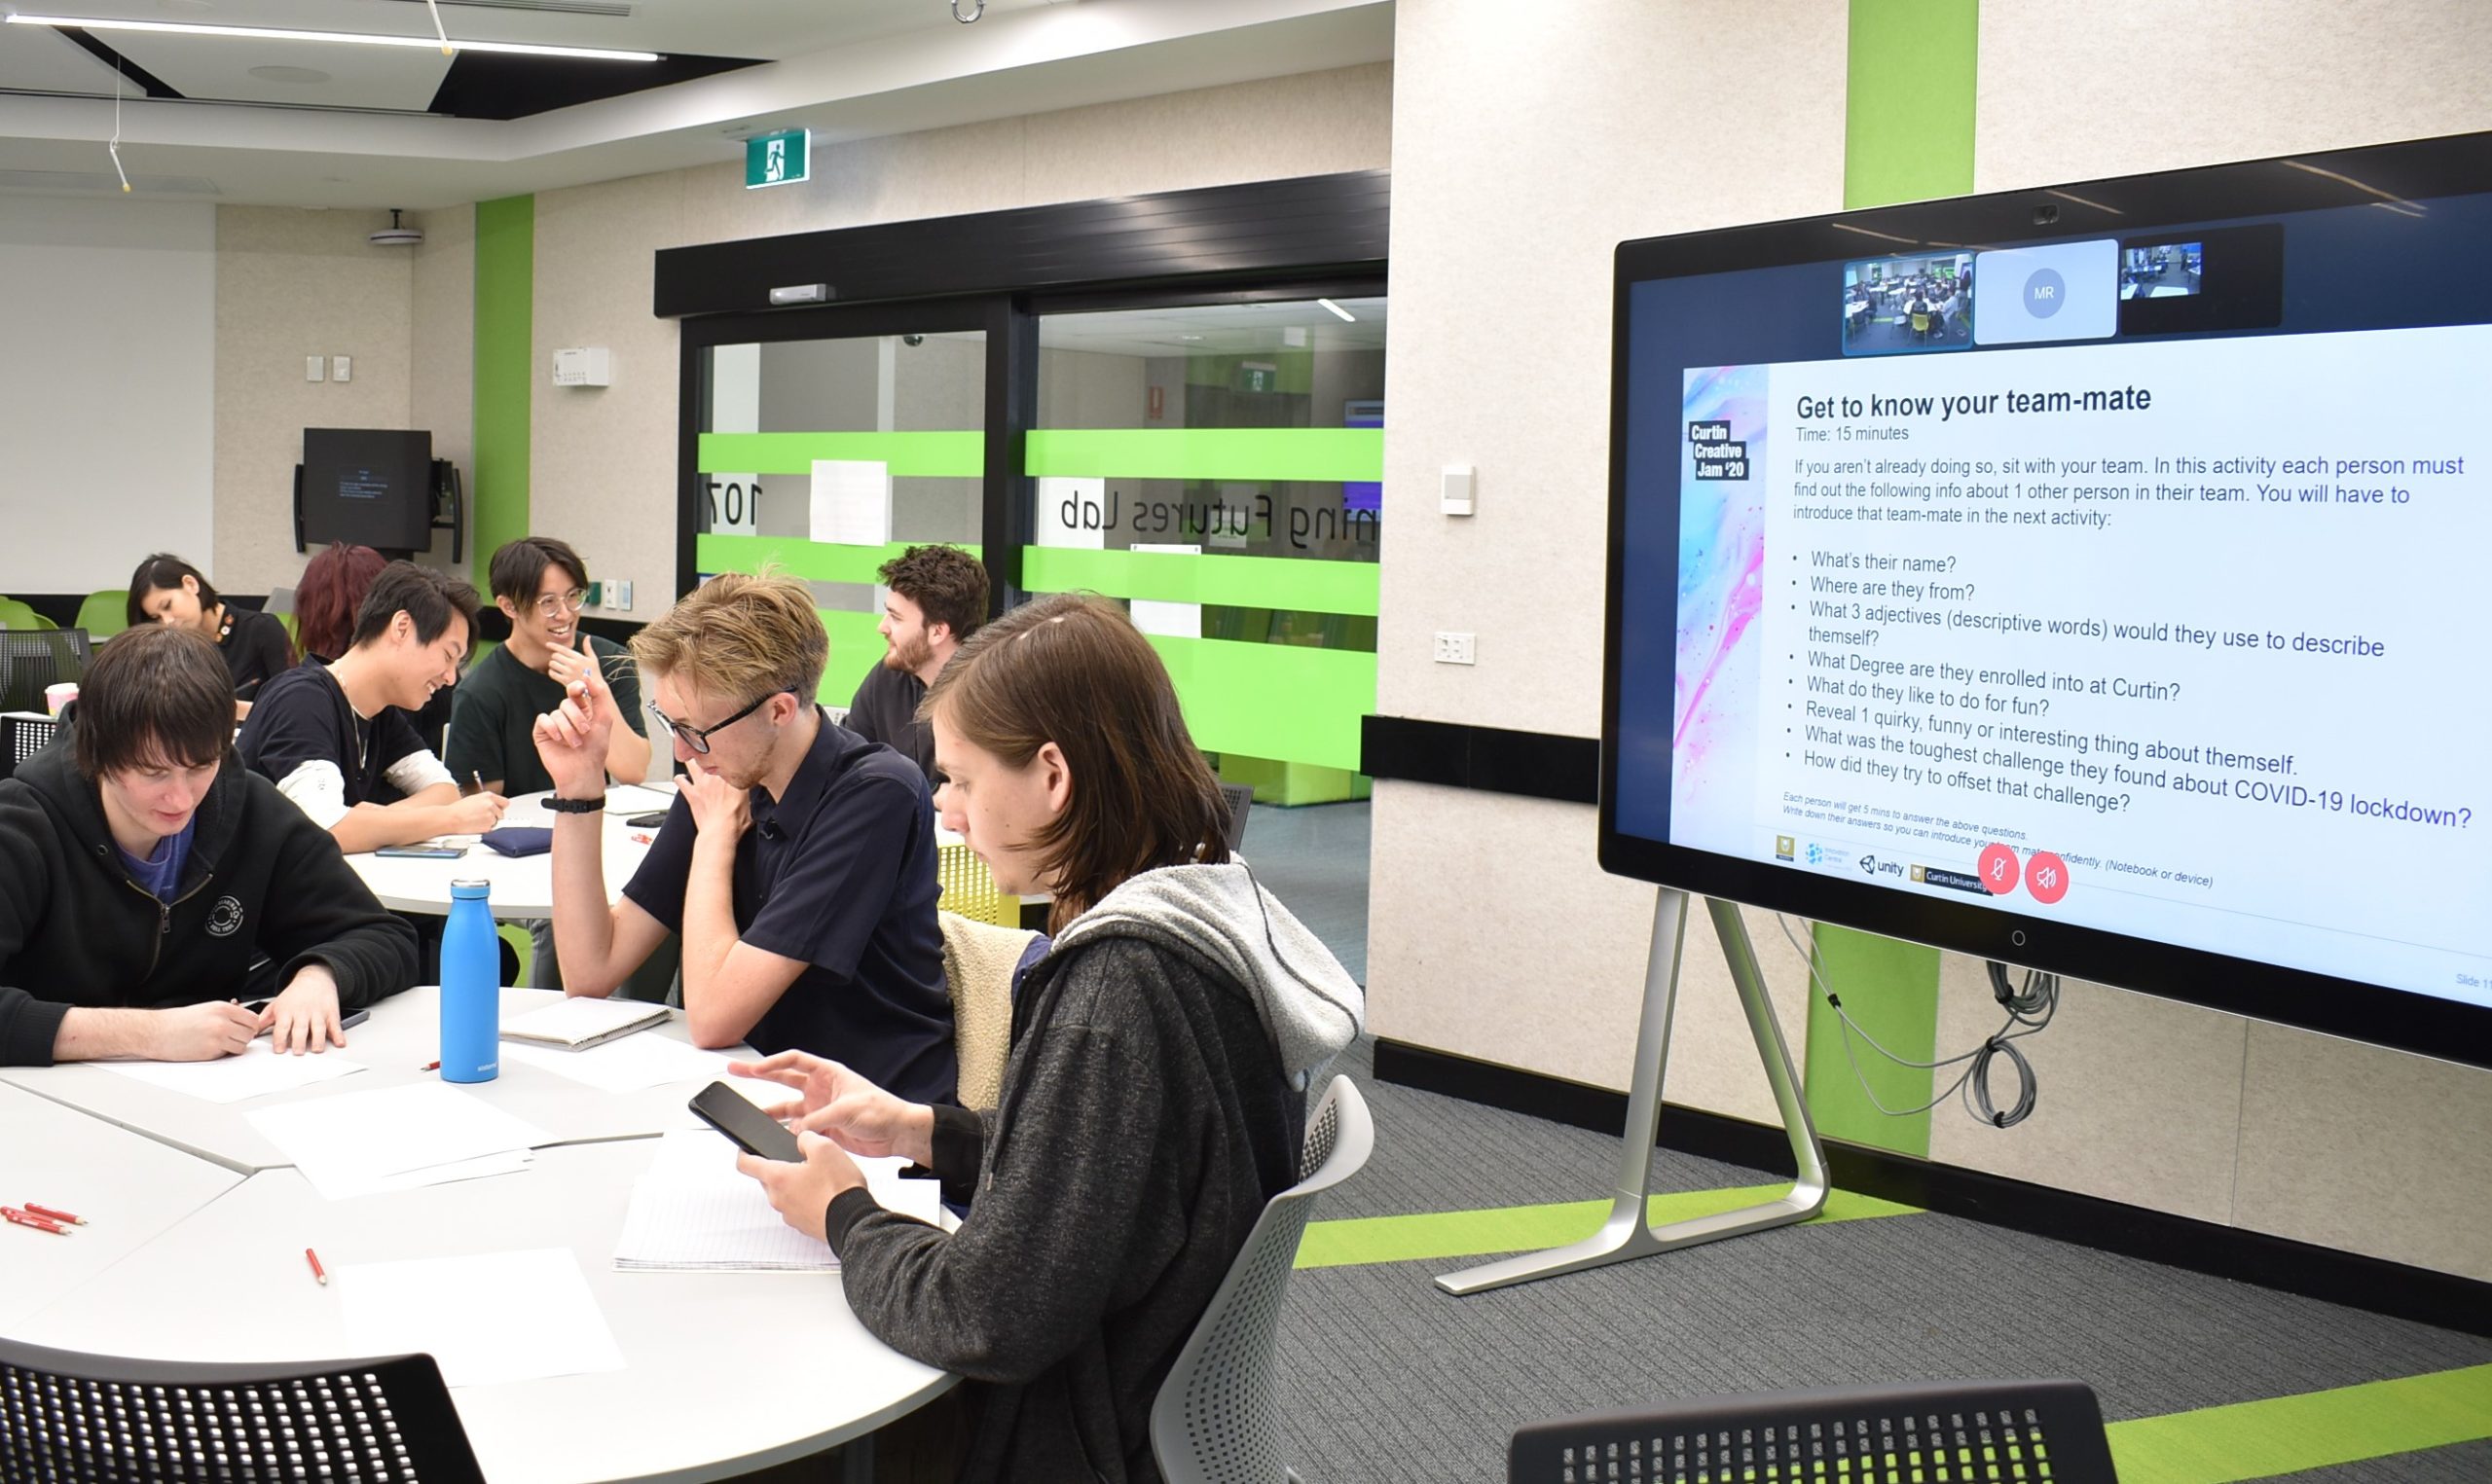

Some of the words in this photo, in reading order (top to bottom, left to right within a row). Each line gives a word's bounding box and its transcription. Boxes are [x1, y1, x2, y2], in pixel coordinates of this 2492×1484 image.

[2034, 286, 2055, 301] MR
[1796, 395, 1836, 420] Get
[1840, 395, 1864, 418] to
[1870, 392, 1935, 417] know
[1940, 393, 2000, 422] your
[2005, 384, 2152, 415] team-mate
[1691, 424, 1727, 441] Curtin
[1795, 426, 1831, 442] Time:
[1836, 425, 1852, 442] 15
[1855, 425, 1910, 441] minutes
[1695, 443, 1742, 459] Creative
[1697, 461, 1723, 478] Jam
[1795, 458, 1804, 474] If
[1806, 462, 1830, 478] you
[1833, 458, 1872, 474] aren't
[1874, 458, 1927, 478] already
[1930, 457, 1971, 479] doing
[1975, 461, 1997, 477] so,
[2001, 457, 2021, 474] sit
[2024, 456, 2056, 474] with
[2060, 460, 2098, 479] your
[2101, 457, 2148, 474] team.
[2154, 456, 2171, 474] In
[2175, 455, 2208, 474] this
[2212, 455, 2277, 479] activity
[2282, 455, 2329, 475] each
[2335, 459, 2405, 480] person
[2412, 455, 2465, 475] must
[1793, 481, 1817, 497] find
[1820, 482, 1842, 497] out
[1845, 482, 1867, 497] the
[1869, 482, 1931, 502] following
[1935, 482, 1962, 498] info
[1965, 482, 2009, 499] about
[2014, 482, 2021, 499] 1
[2027, 482, 2070, 500] other
[2072, 487, 2130, 504] person
[2135, 483, 2150, 500] in
[2155, 483, 2195, 501] their
[2199, 484, 2251, 502] team.
[2255, 483, 2292, 503] You
[2297, 484, 2328, 503] will
[2335, 484, 2385, 504] have
[2390, 486, 2410, 504] to
[1793, 504, 1853, 521] introduce
[1856, 505, 1883, 522] that
[1887, 506, 1963, 523] team-mate
[1966, 506, 1980, 523] in
[1984, 506, 2009, 525] the
[2013, 508, 2047, 525] next
[2050, 508, 2111, 530] activity:
[1811, 550, 1860, 569] What's
[1864, 553, 1898, 571] their
[1902, 555, 1957, 573] name?
[1810, 575, 1858, 595] Where
[1861, 582, 1887, 597] are
[1890, 579, 1925, 602] they
[1928, 581, 1975, 601] from?
[1809, 599, 1848, 619] What
[1851, 602, 1861, 620] 3
[1864, 603, 1942, 627] adjectives
[1947, 608, 2042, 634] (descriptive
[2047, 617, 2108, 642] words)
[2113, 622, 2169, 642] would
[2174, 623, 2217, 650] they
[2222, 631, 2259, 648] use
[2265, 630, 2286, 650] to
[2291, 631, 2385, 658] describe
[1809, 625, 1880, 647] themself?
[1808, 649, 1846, 670] What
[1850, 653, 1905, 677] Degree
[1909, 664, 1935, 678] are
[1939, 662, 1974, 686] they
[1978, 669, 2046, 689] enrolled
[2052, 671, 2084, 693] into
[2089, 676, 2107, 696] at
[2112, 677, 2180, 702] Curtin?
[1807, 674, 1845, 696] What
[1848, 679, 1868, 698] do
[1871, 681, 1905, 706] they
[1908, 685, 1935, 705] like
[1939, 689, 1955, 707] to
[1959, 691, 1980, 709] do
[1984, 693, 2008, 713] for
[2011, 695, 2050, 717] fun?
[1806, 700, 1856, 722] Reveal
[1861, 706, 1868, 724] 1
[1874, 709, 1923, 734] quirky,
[1927, 713, 1973, 741] funny
[1977, 724, 1995, 739] or
[1998, 721, 2089, 755] interesting
[2094, 733, 2139, 761] thing
[2144, 740, 2200, 764] about
[2205, 745, 2298, 776] themself.
[1804, 748, 1837, 770] How
[1840, 755, 1862, 774] did
[1866, 758, 1899, 783] they
[1903, 764, 1924, 786] try
[1927, 767, 1943, 785] to
[1946, 770, 1993, 793] offset
[1997, 777, 2029, 798] that
[2033, 781, 2131, 814] challenge?
[1805, 724, 1843, 745] What
[1846, 734, 1877, 749] was
[1881, 735, 1905, 753] the
[1909, 739, 1978, 764] toughest
[1982, 747, 2065, 778] challenge
[2070, 758, 2109, 785] they
[2113, 763, 2167, 789] found
[2172, 772, 2228, 797] about
[2234, 778, 2344, 812] COVID-19
[2350, 793, 2473, 829] lockdown?
[1783, 791, 1804, 802] Each
[1805, 796, 1832, 810] person
[1834, 800, 1847, 811] will
[1848, 804, 1861, 814] get
[1863, 805, 1869, 814] 5
[1871, 808, 1890, 818] mins
[1892, 810, 1901, 819] to
[1903, 814, 1934, 825] answer
[1936, 816, 1950, 827] the
[1952, 819, 1979, 833] above
[1783, 805, 1803, 816] Write
[1805, 809, 1826, 820] down
[1828, 813, 1846, 823] their
[1847, 816, 1882, 830] answers
[1883, 822, 1893, 832] so
[1895, 825, 1912, 836] you
[1913, 828, 1929, 839] can
[1930, 831, 1971, 846] introduce
[2106, 859, 2158, 878] (Notebook
[2161, 870, 2173, 880] or
[2175, 871, 2214, 889] device)
[1878, 861, 1905, 878] unity
[1926, 871, 1949, 883] Curtin
[2455, 973, 2479, 987] Slide
